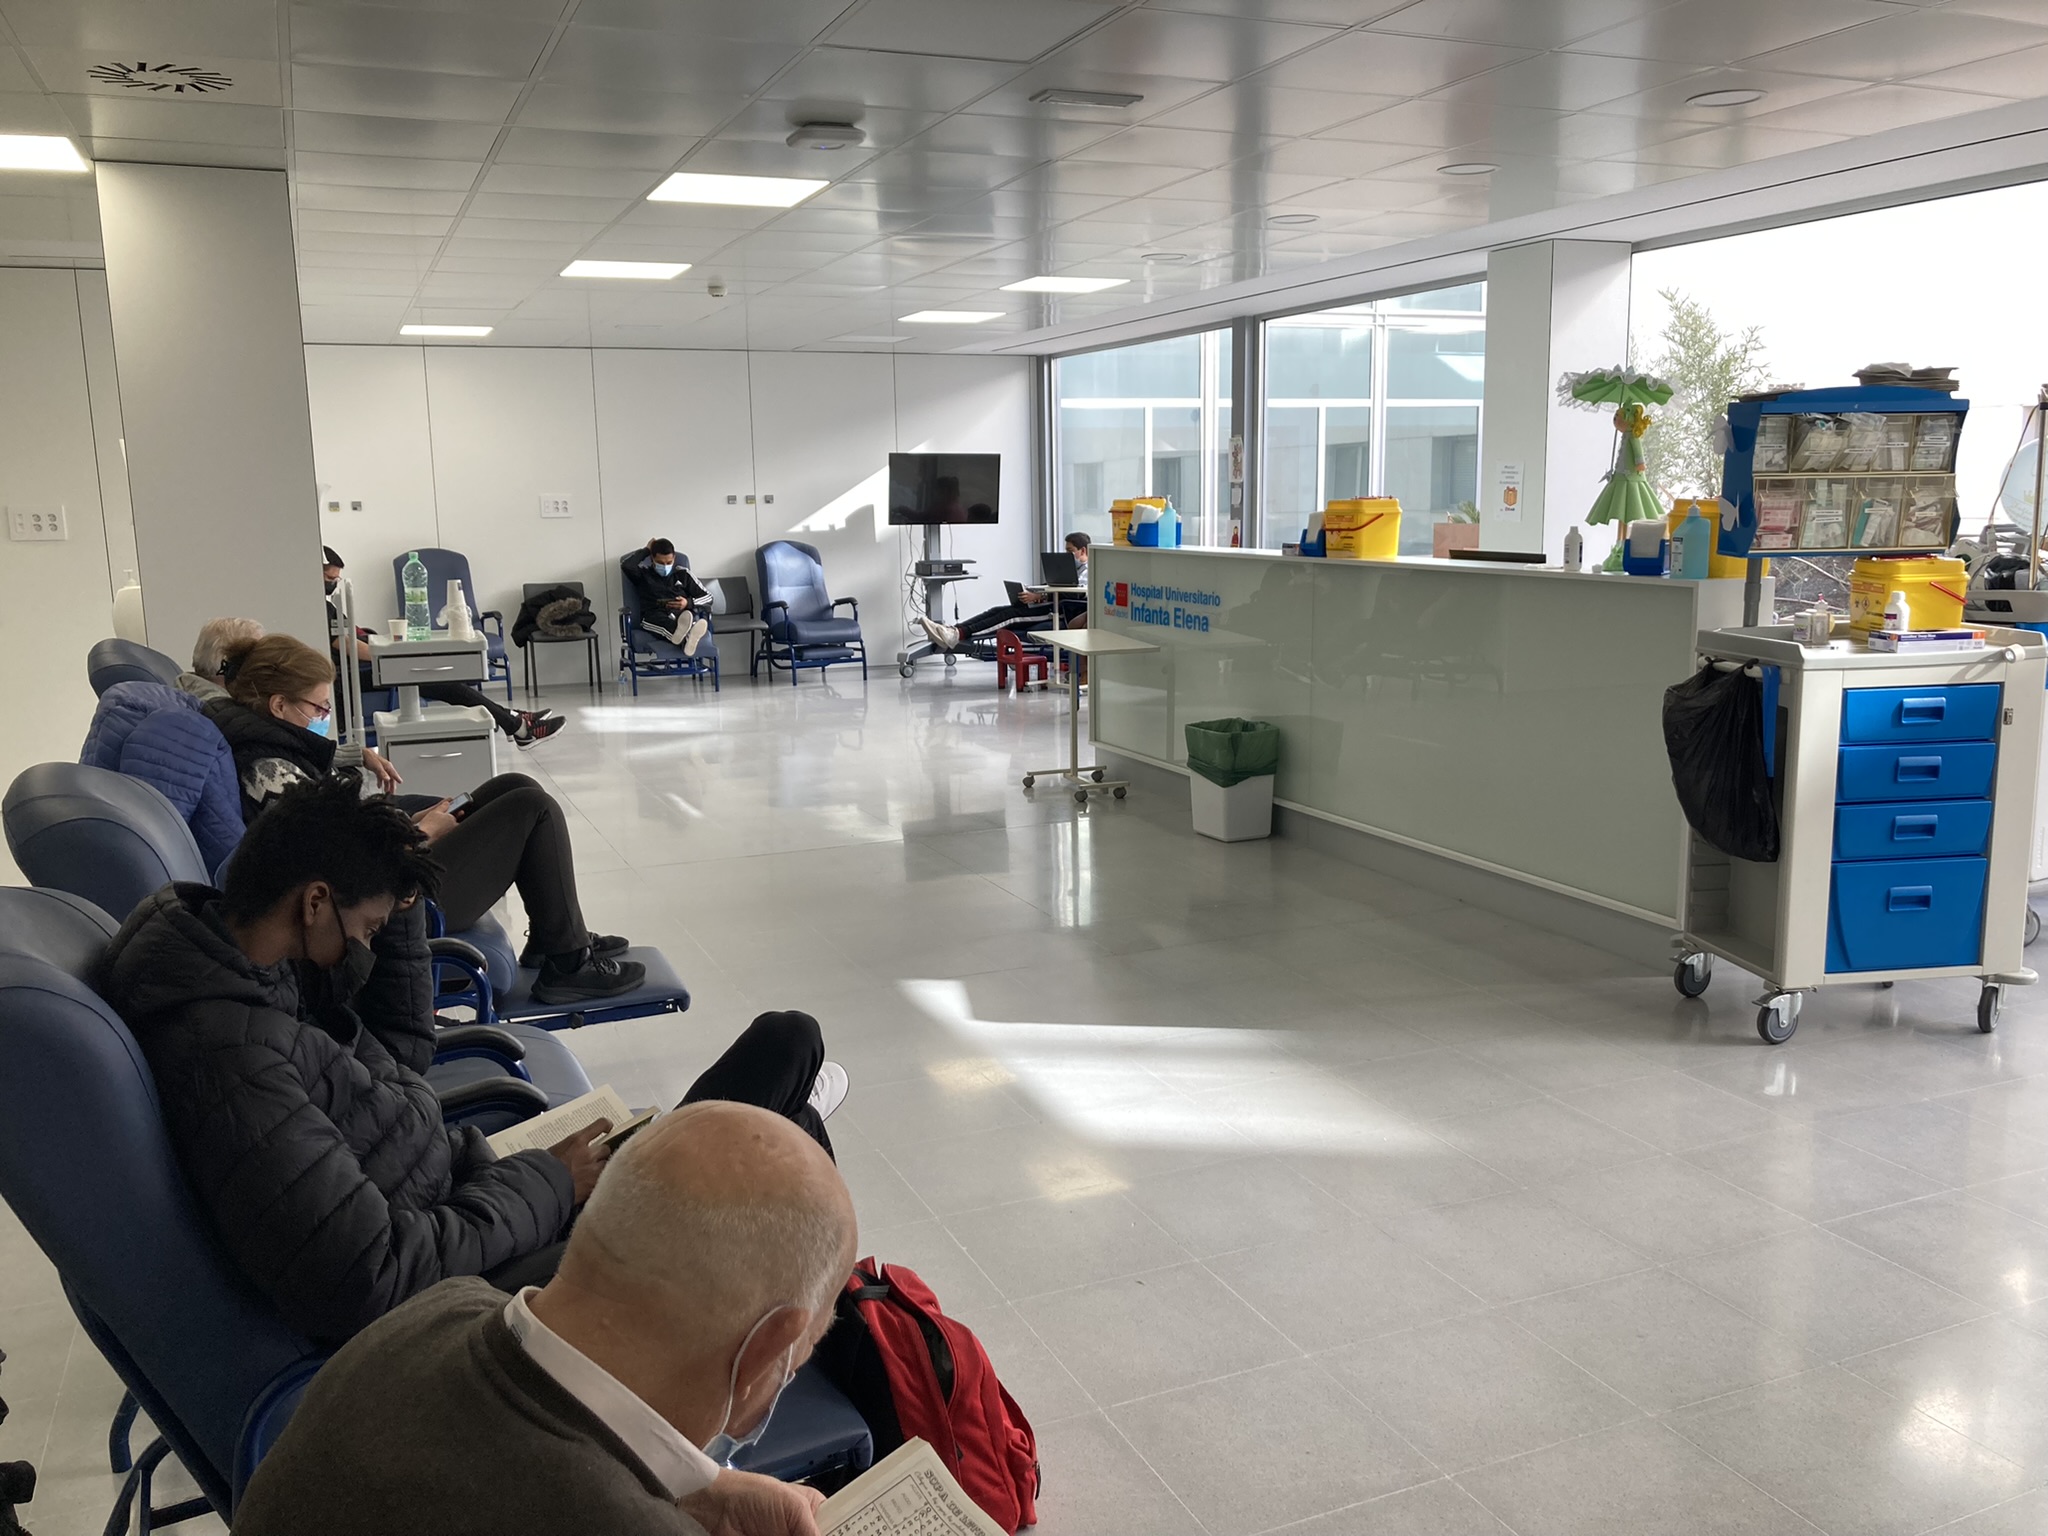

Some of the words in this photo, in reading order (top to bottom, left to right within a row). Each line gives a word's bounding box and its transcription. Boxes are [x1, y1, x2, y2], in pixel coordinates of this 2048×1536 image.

[1130, 582, 1163, 601] Hospital
[1165, 586, 1221, 607] Universitario
[1130, 601, 1170, 626] Infanta
[1173, 607, 1209, 632] Elena
